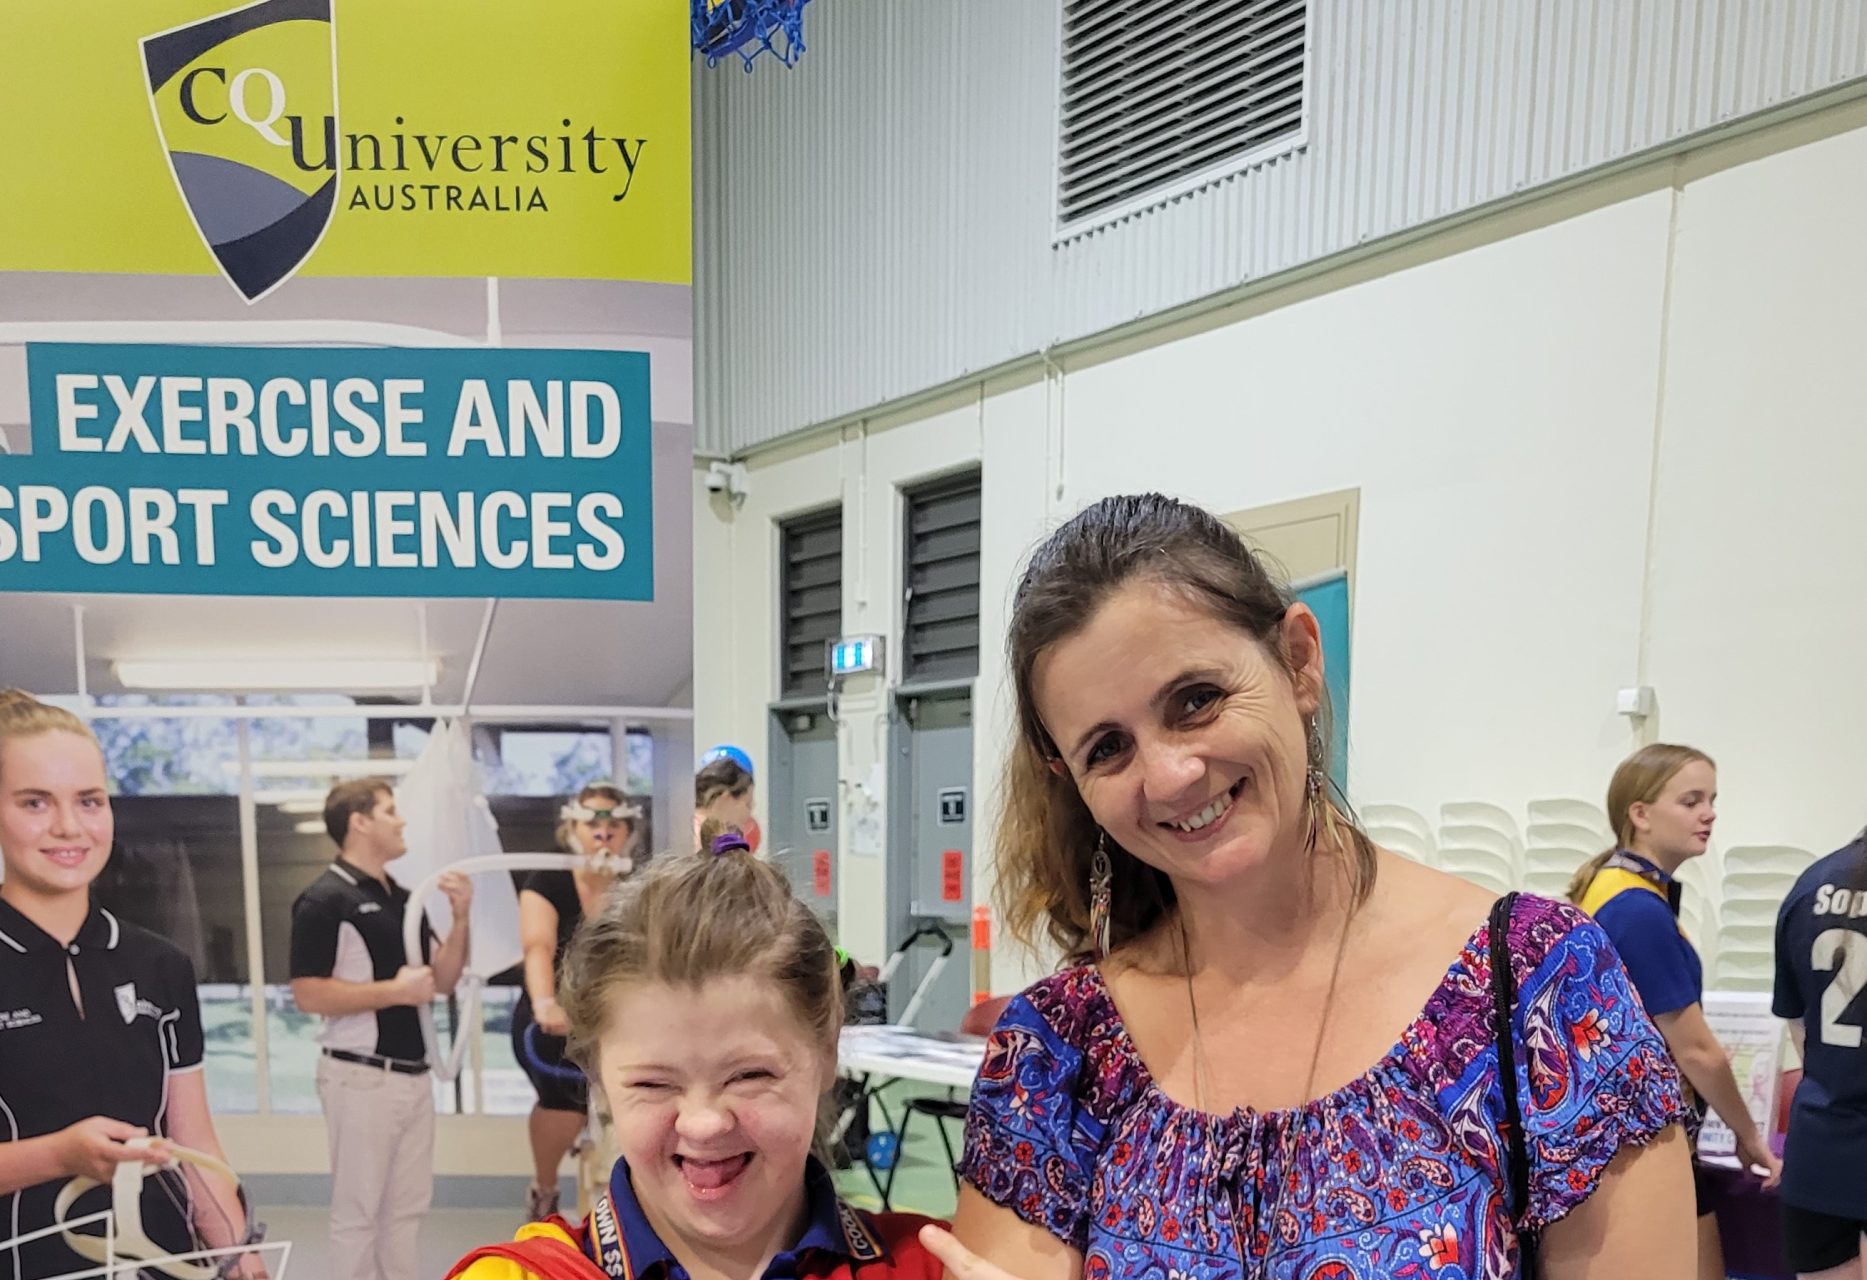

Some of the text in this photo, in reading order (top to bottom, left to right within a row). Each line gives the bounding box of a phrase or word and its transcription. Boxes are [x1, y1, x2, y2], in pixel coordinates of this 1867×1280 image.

[348, 184, 549, 212] AUSTRALIA
[56, 374, 622, 458] EXERCISE AND
[250, 490, 625, 570] SCIENCES
[604, 1249, 624, 1277] SS
